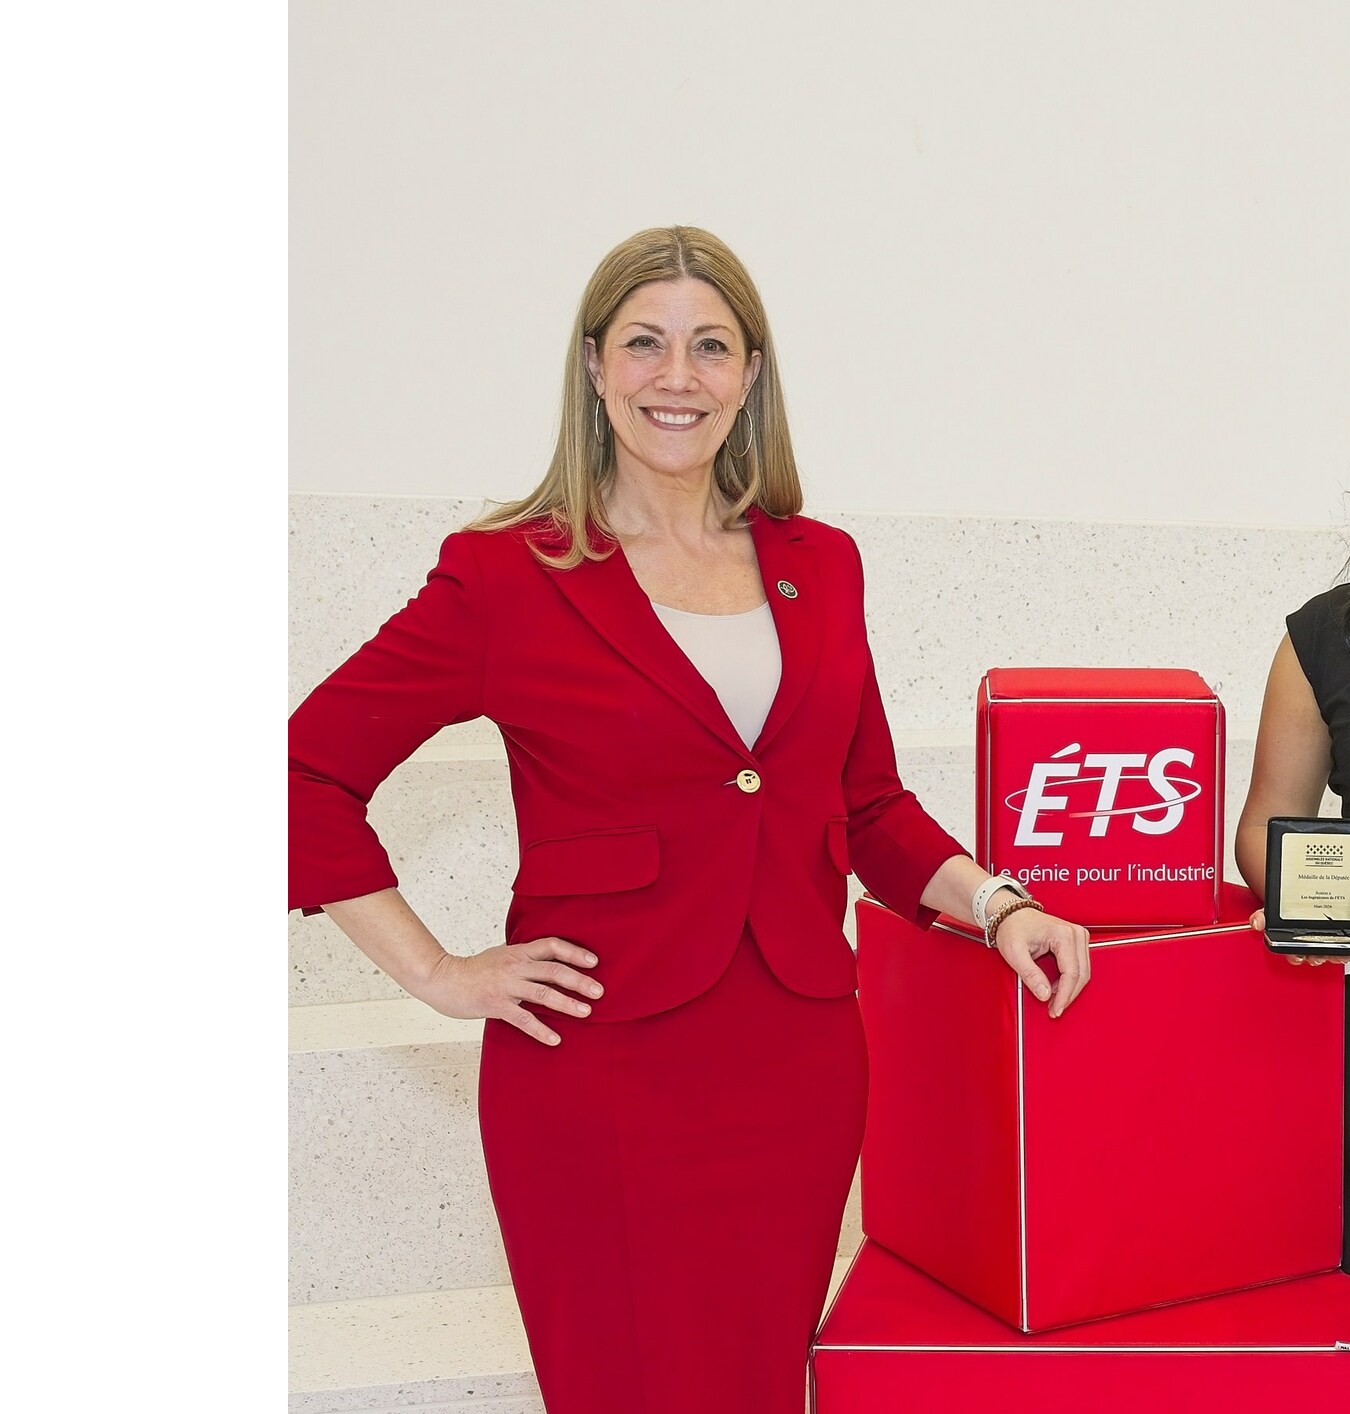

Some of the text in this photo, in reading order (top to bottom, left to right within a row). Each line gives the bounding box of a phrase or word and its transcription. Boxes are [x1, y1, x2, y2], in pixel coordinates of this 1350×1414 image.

[1013, 742, 1196, 847] ÉTS
[1018, 864, 1070, 885] génie
[1076, 867, 1121, 886] pour
[1127, 863, 1215, 882] l'industrie
